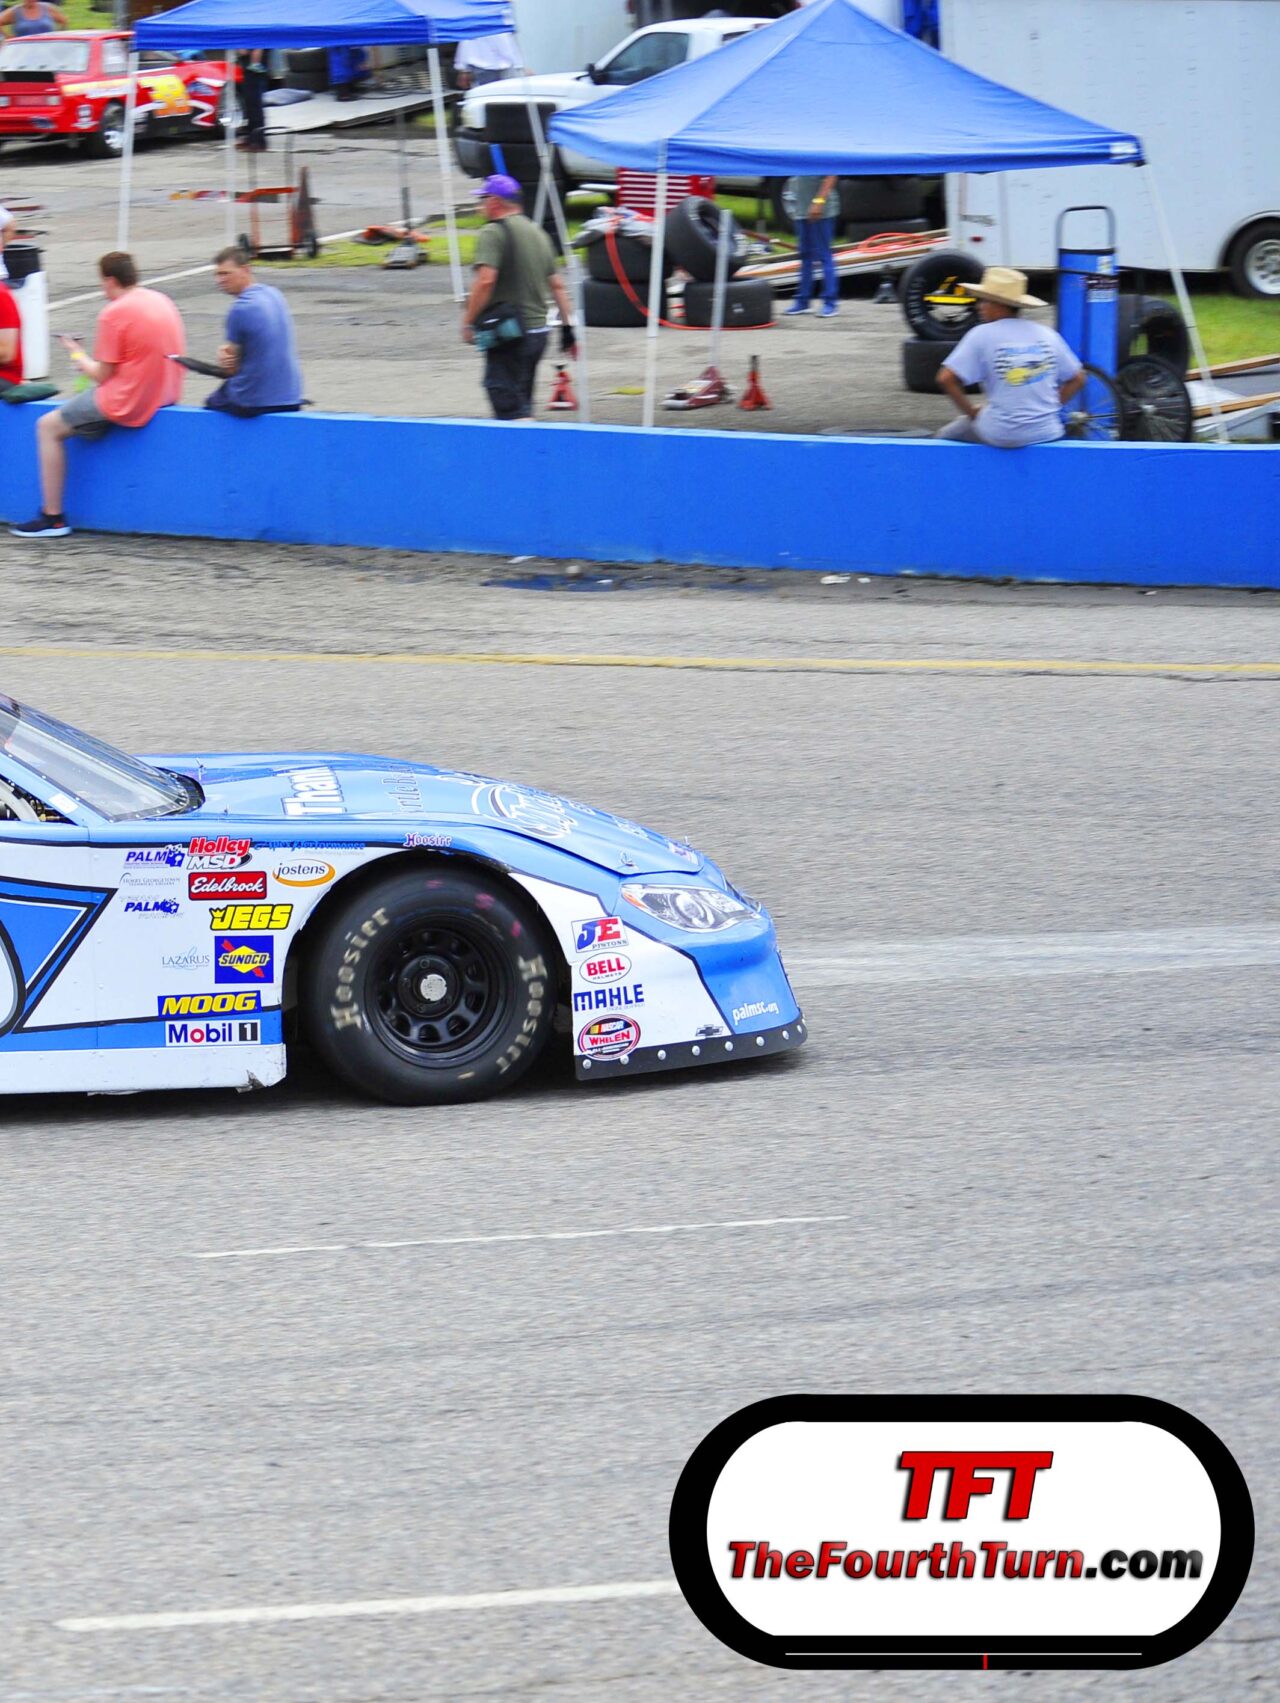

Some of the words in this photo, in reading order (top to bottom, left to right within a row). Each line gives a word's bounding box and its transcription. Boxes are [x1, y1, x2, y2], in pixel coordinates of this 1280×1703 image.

[188, 836, 252, 857] Holley
[403, 833, 452, 848] Hoosier
[126, 851, 167, 862] PALM
[186, 853, 246, 870] MSD
[277, 863, 326, 880] jostens
[191, 876, 264, 893] Edelbrock
[210, 904, 293, 930] JEGS
[577, 917, 622, 950] JE
[161, 953, 210, 966] LAZARUS
[220, 953, 269, 965] SUNOCO
[331, 907, 389, 1031] Hoosier
[586, 957, 626, 977] BELL
[162, 993, 257, 1015] MOOG
[573, 983, 645, 1012] MAHLE
[496, 953, 548, 1074] Hoosier
[732, 1001, 780, 1026] palmsc.org
[169, 1022, 233, 1044] Mobil
